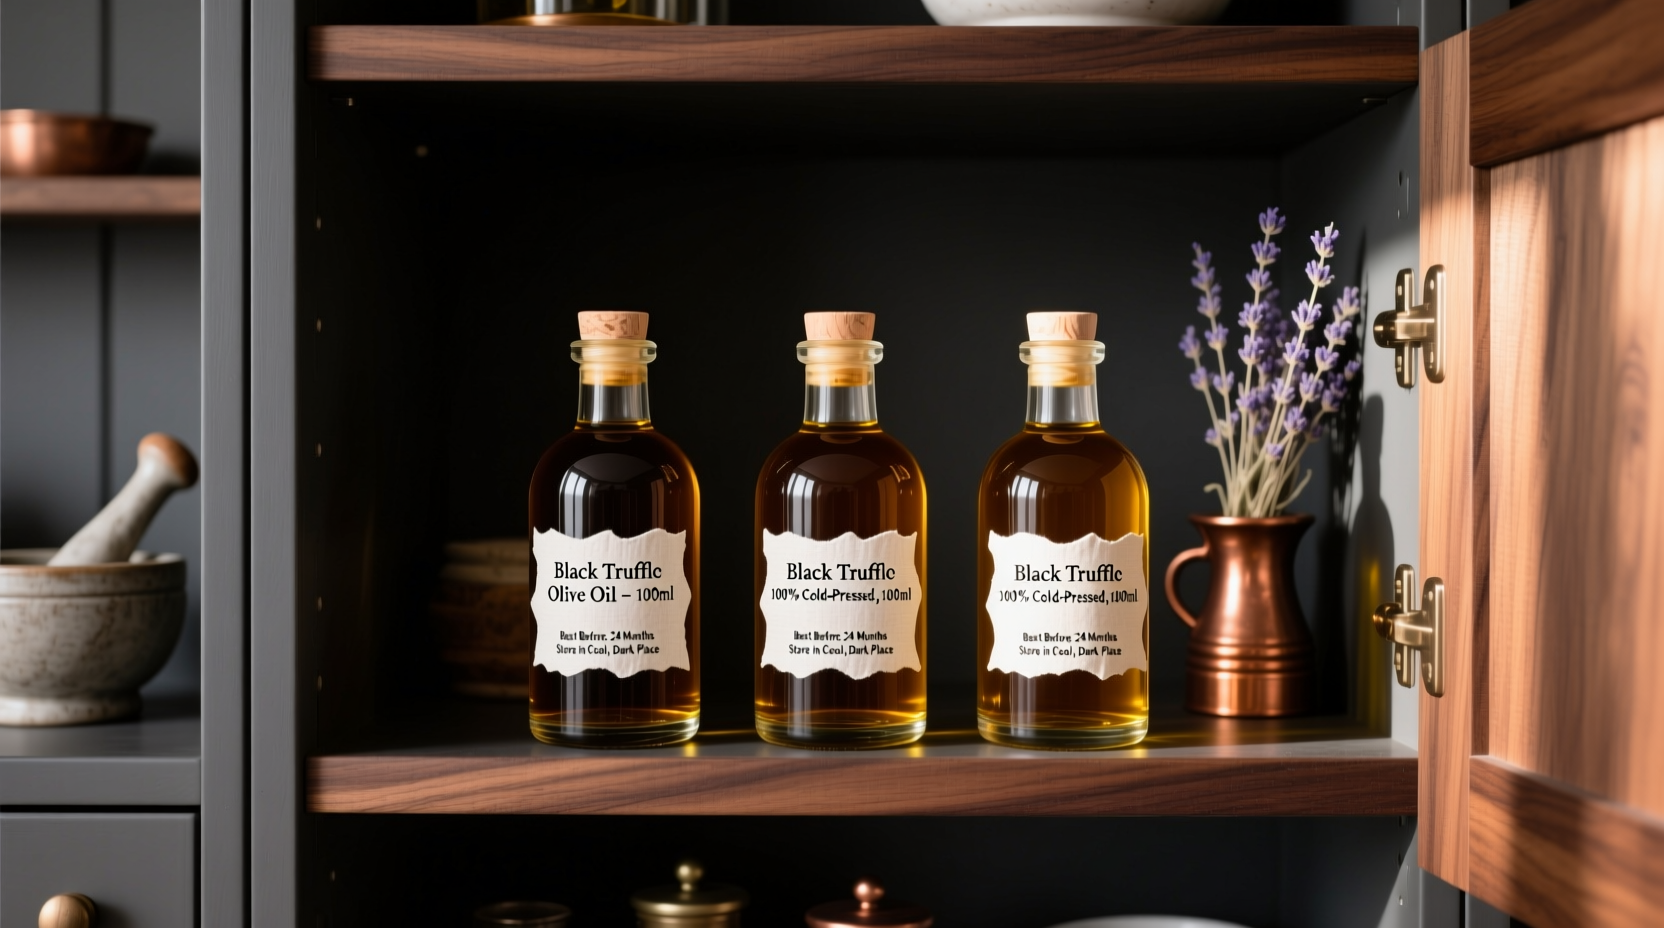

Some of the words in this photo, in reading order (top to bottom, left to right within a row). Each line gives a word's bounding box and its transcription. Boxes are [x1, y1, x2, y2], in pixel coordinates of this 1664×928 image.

[553, 561, 598, 579] Black
[786, 562, 832, 580] Black
[1014, 564, 1061, 582] Black
[548, 585, 585, 602] Olive
[590, 586, 616, 602] Oil
[636, 585, 674, 602] 100ml
[771, 588, 799, 601] 100%
[802, 588, 879, 604] Cold-Pressed,
[882, 587, 911, 601] 100ml
[1033, 589, 1109, 605] Cold-Pressed,
[1043, 646, 1050, 655] in
